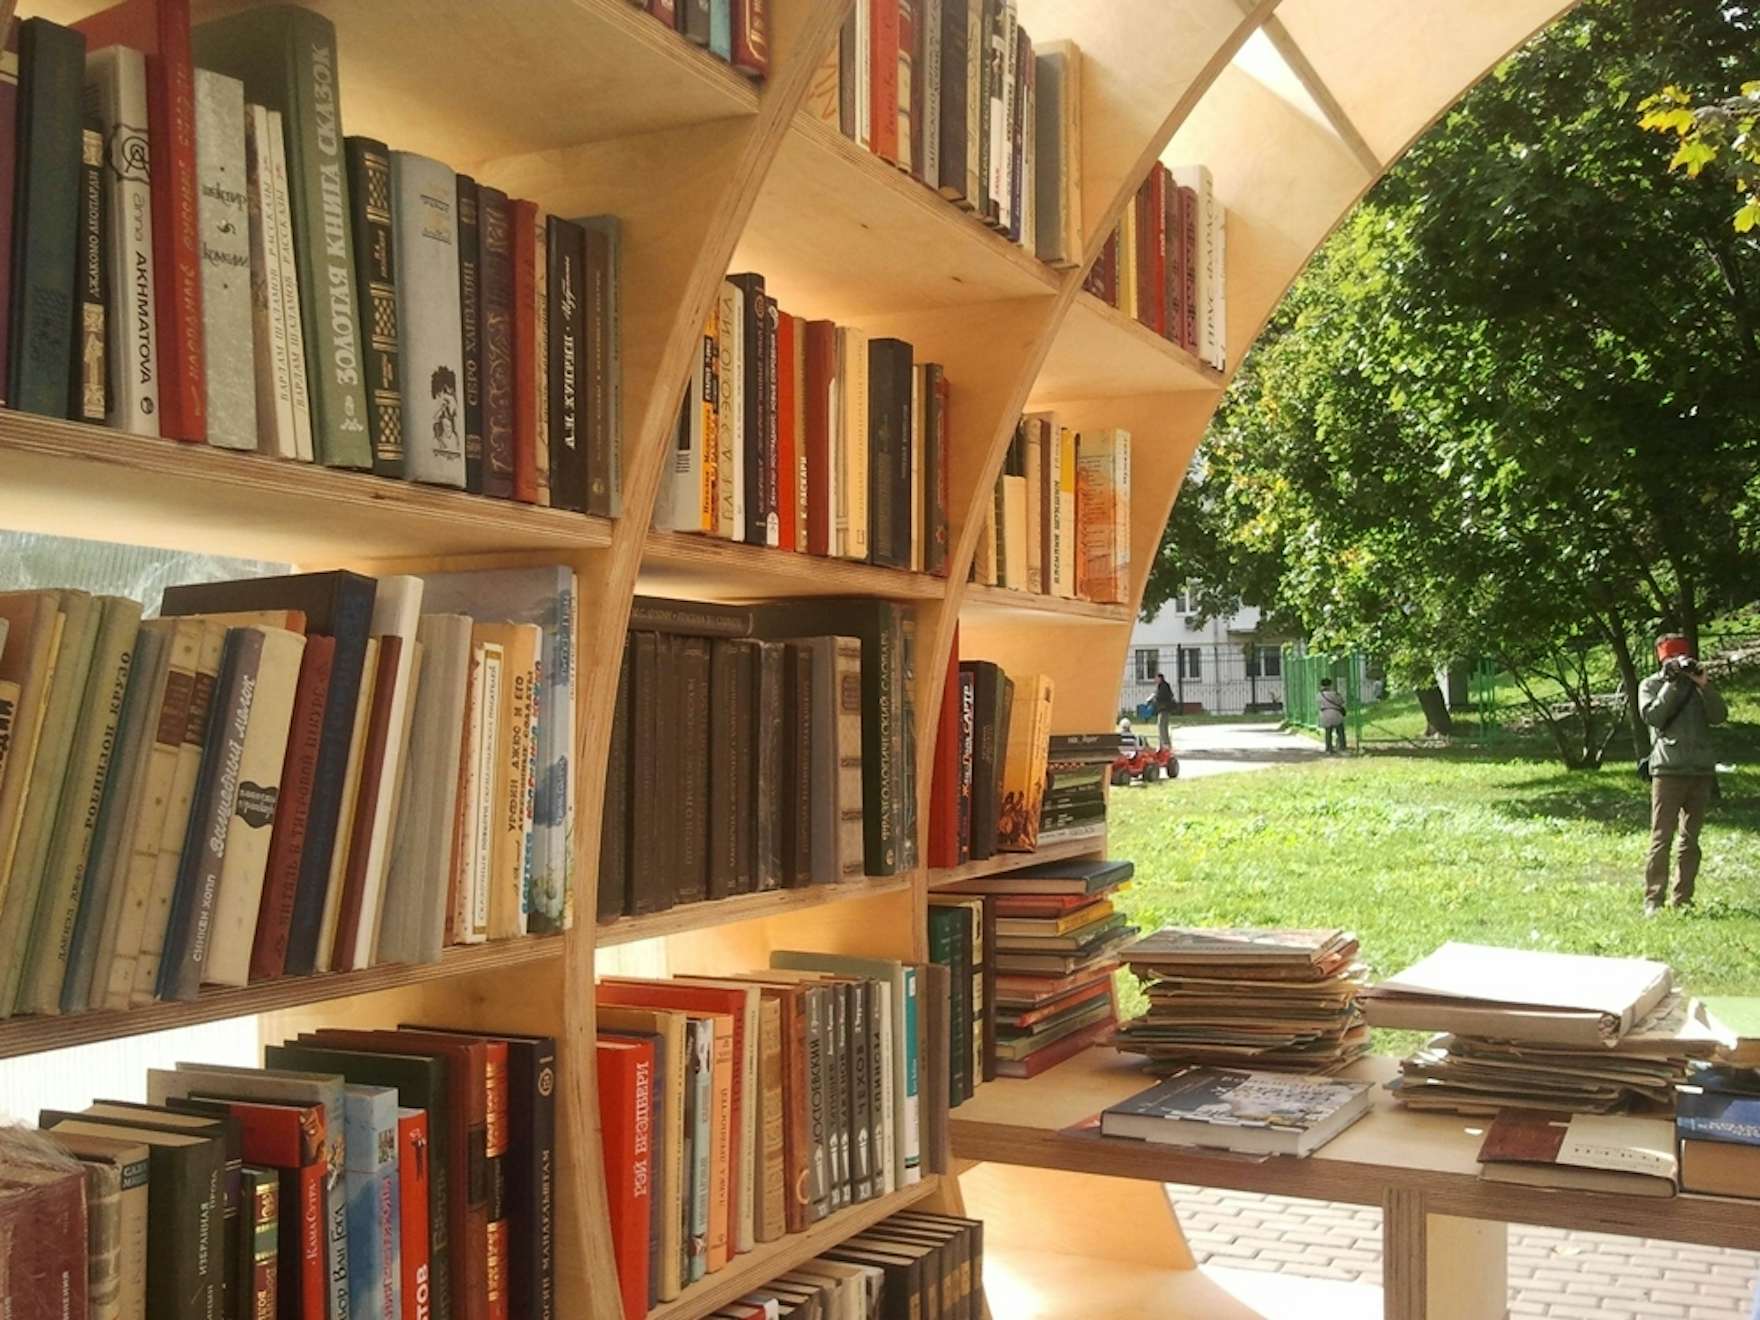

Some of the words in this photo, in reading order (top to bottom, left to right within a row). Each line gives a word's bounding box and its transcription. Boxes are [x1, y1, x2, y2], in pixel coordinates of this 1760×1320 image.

[314, 43, 339, 156] СКАЗОК
[322, 162, 348, 259] КНИГА
[136, 251, 151, 385] AKHMATOVA
[268, 269, 284, 339] ШАЛАМОВ
[283, 275, 300, 346] ШАЛАМОВ
[328, 264, 358, 386] ЗОЛОТАЯ
[277, 345, 289, 401] ВАРЛАМ
[291, 351, 307, 408] ВАРЛАМ
[562, 334, 576, 410] КУПРИН
[514, 674, 524, 700] ЕГО
[880, 630, 889, 691] СЛОВАРЬ
[85, 725, 114, 829] РОБИНЗОН
[109, 651, 131, 715] КРУЗО
[511, 724, 521, 769] ДЖЮС
[880, 695, 891, 841] ФРАЗЕОЛОГИЧЕСКИЙ
[508, 778, 519, 832] УРФИН
[634, 1061, 649, 1155] БРЭДБЕРИ
[856, 1044, 865, 1116] ЧЕХОВ
[634, 1158, 646, 1198] РЭЙ
[416, 1263, 430, 1320] ТОВ
